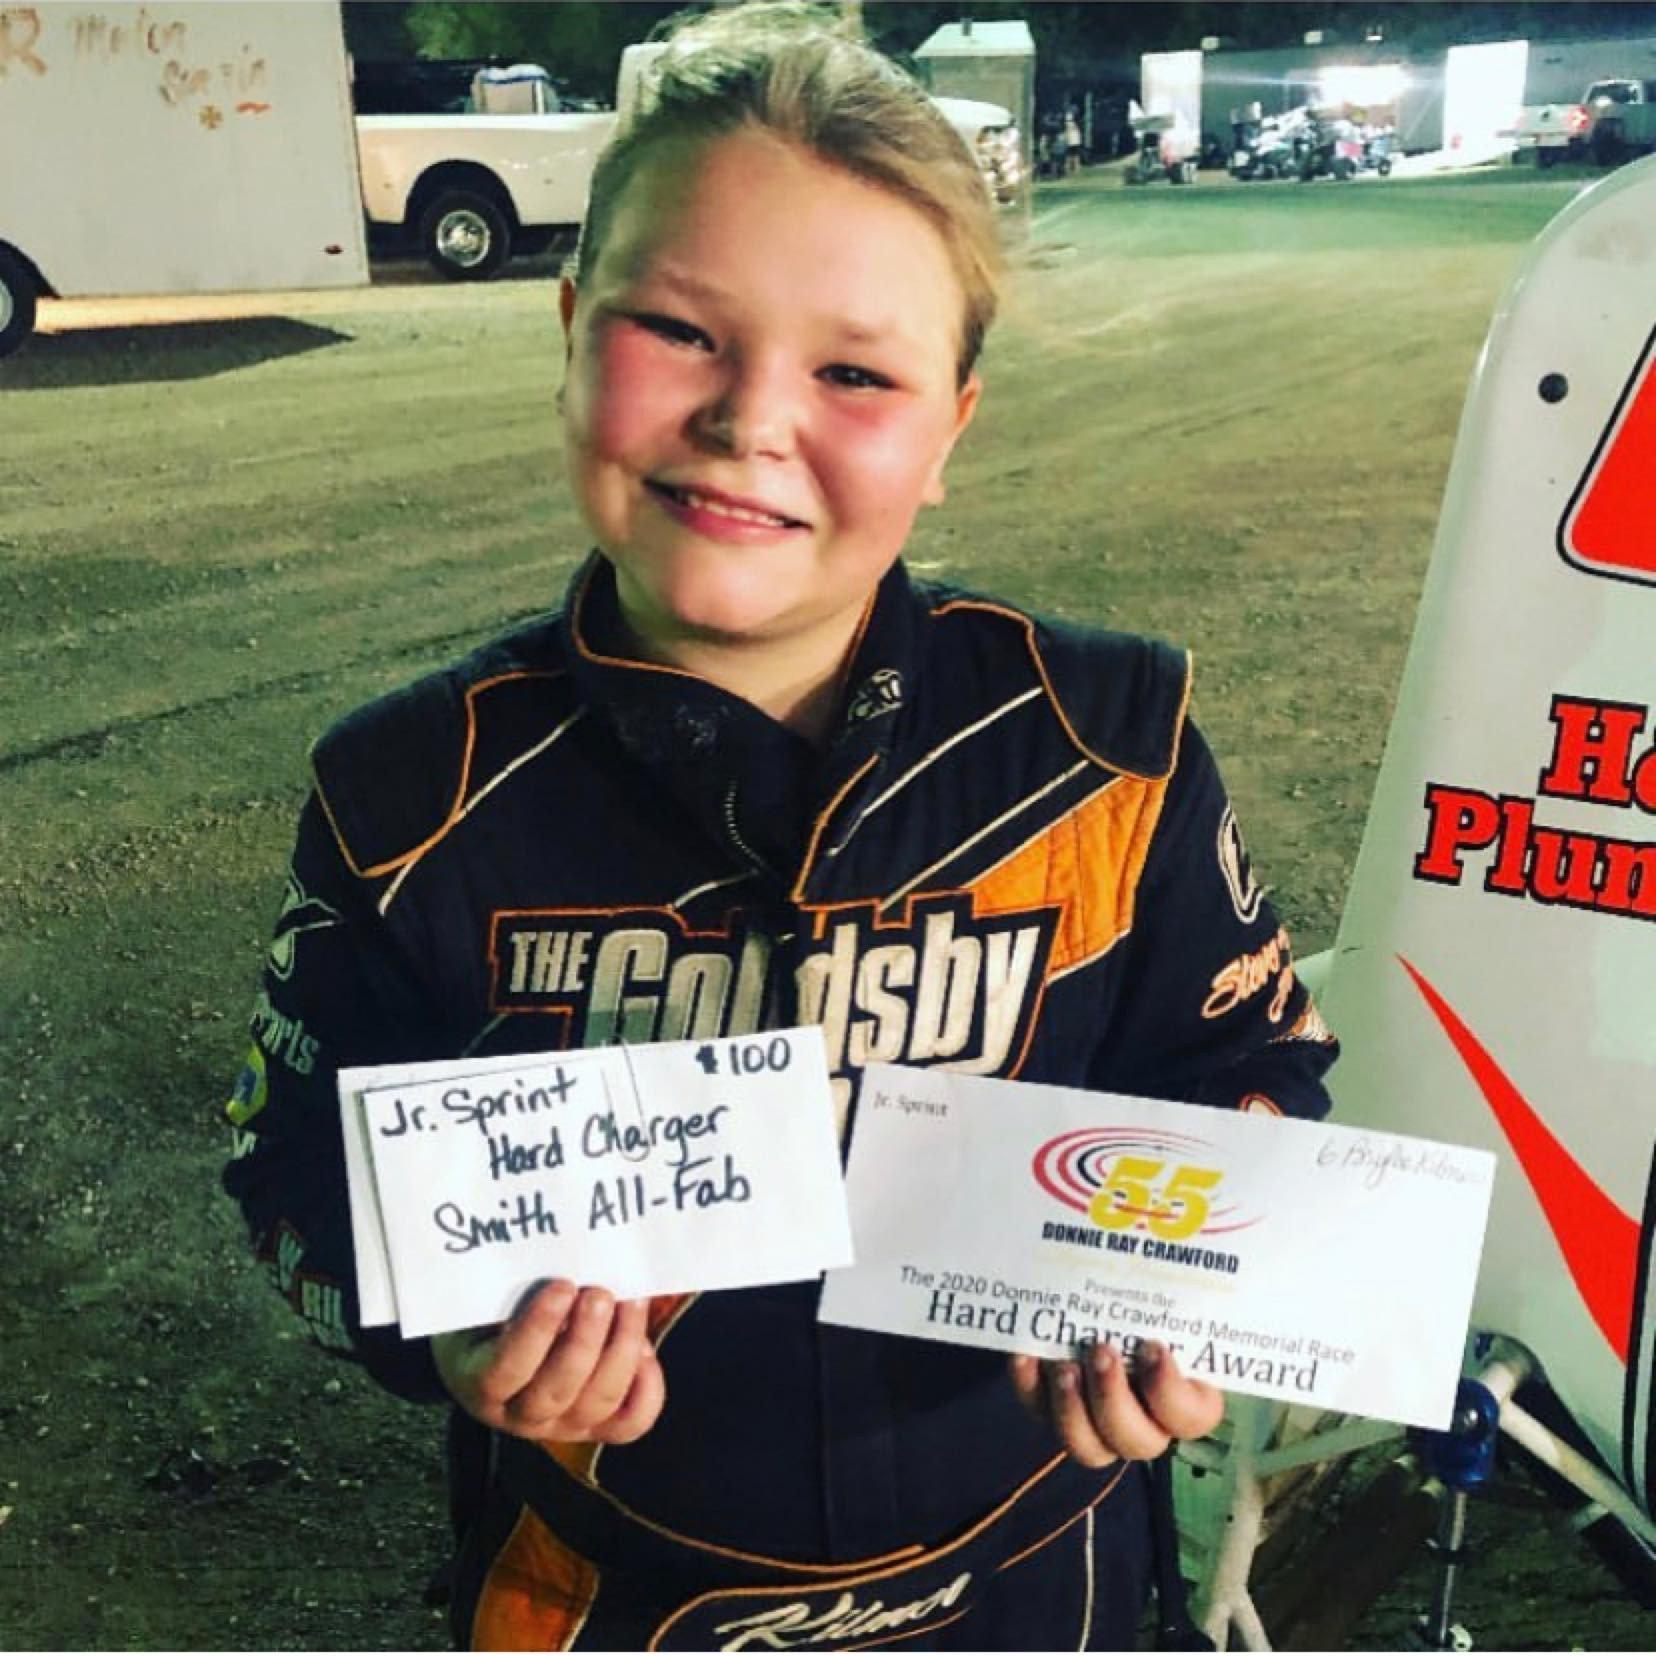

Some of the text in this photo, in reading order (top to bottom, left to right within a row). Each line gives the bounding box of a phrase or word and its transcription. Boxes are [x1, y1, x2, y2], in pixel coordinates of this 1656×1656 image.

[511, 931, 592, 993] THE
[380, 1066, 577, 1138] Jr. Sprint
[488, 1104, 730, 1181] Hard Charger
[433, 1153, 752, 1254] Smith All-Fab
[1042, 1220, 1104, 1249] DONNIE
[1107, 1231, 1140, 1255] RAY
[1143, 1237, 1240, 1275] CRAWFORD
[900, 1264, 1355, 1365] The 2020 Donnie Ray Crawford Memorial Race
[927, 1289, 1318, 1393] Hard Chargr Award
